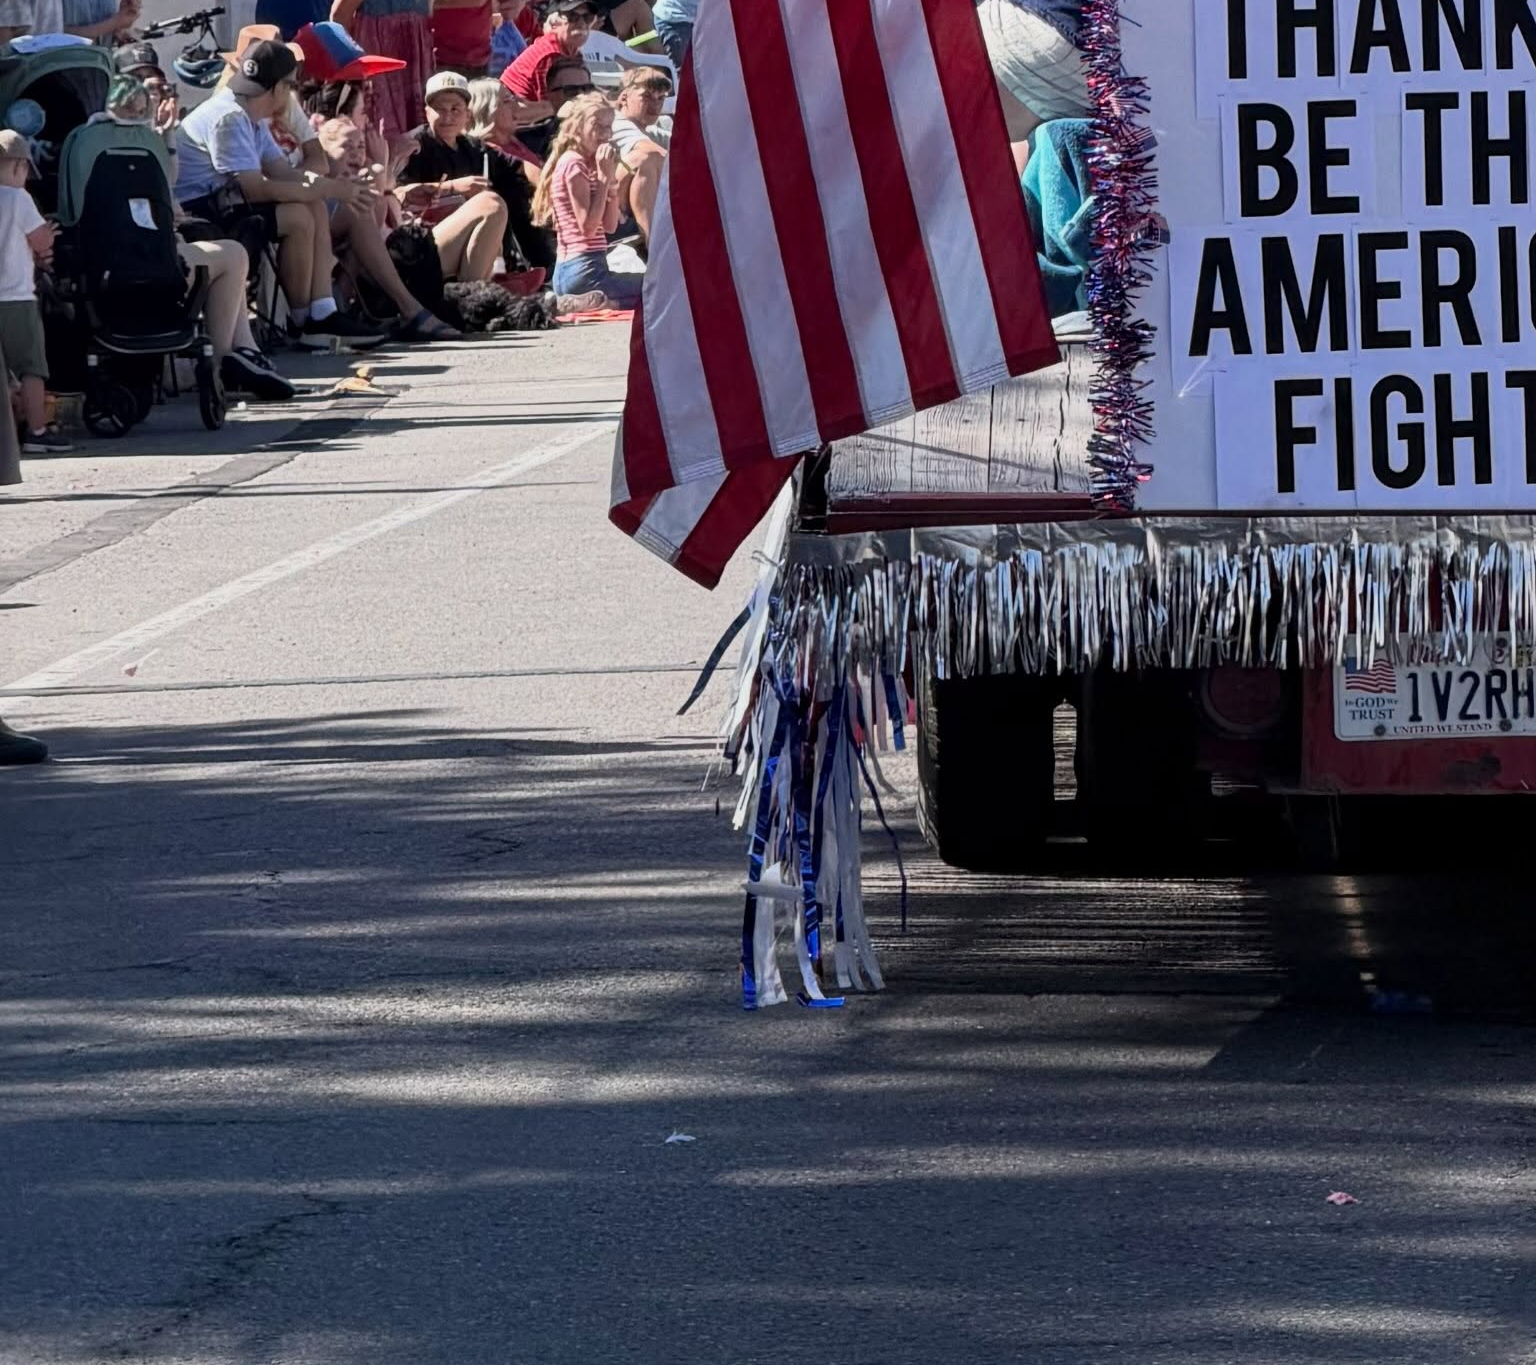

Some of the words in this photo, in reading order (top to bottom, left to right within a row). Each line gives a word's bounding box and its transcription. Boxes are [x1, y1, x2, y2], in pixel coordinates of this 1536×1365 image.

[1237, 99, 1360, 218] BE
[1406, 668, 1535, 722] 1V2RH
[1355, 697, 1386, 708] GOD
[1349, 709, 1395, 721] TRUST
[1394, 725, 1434, 734] UNITED
[1456, 723, 1492, 732] STAND
